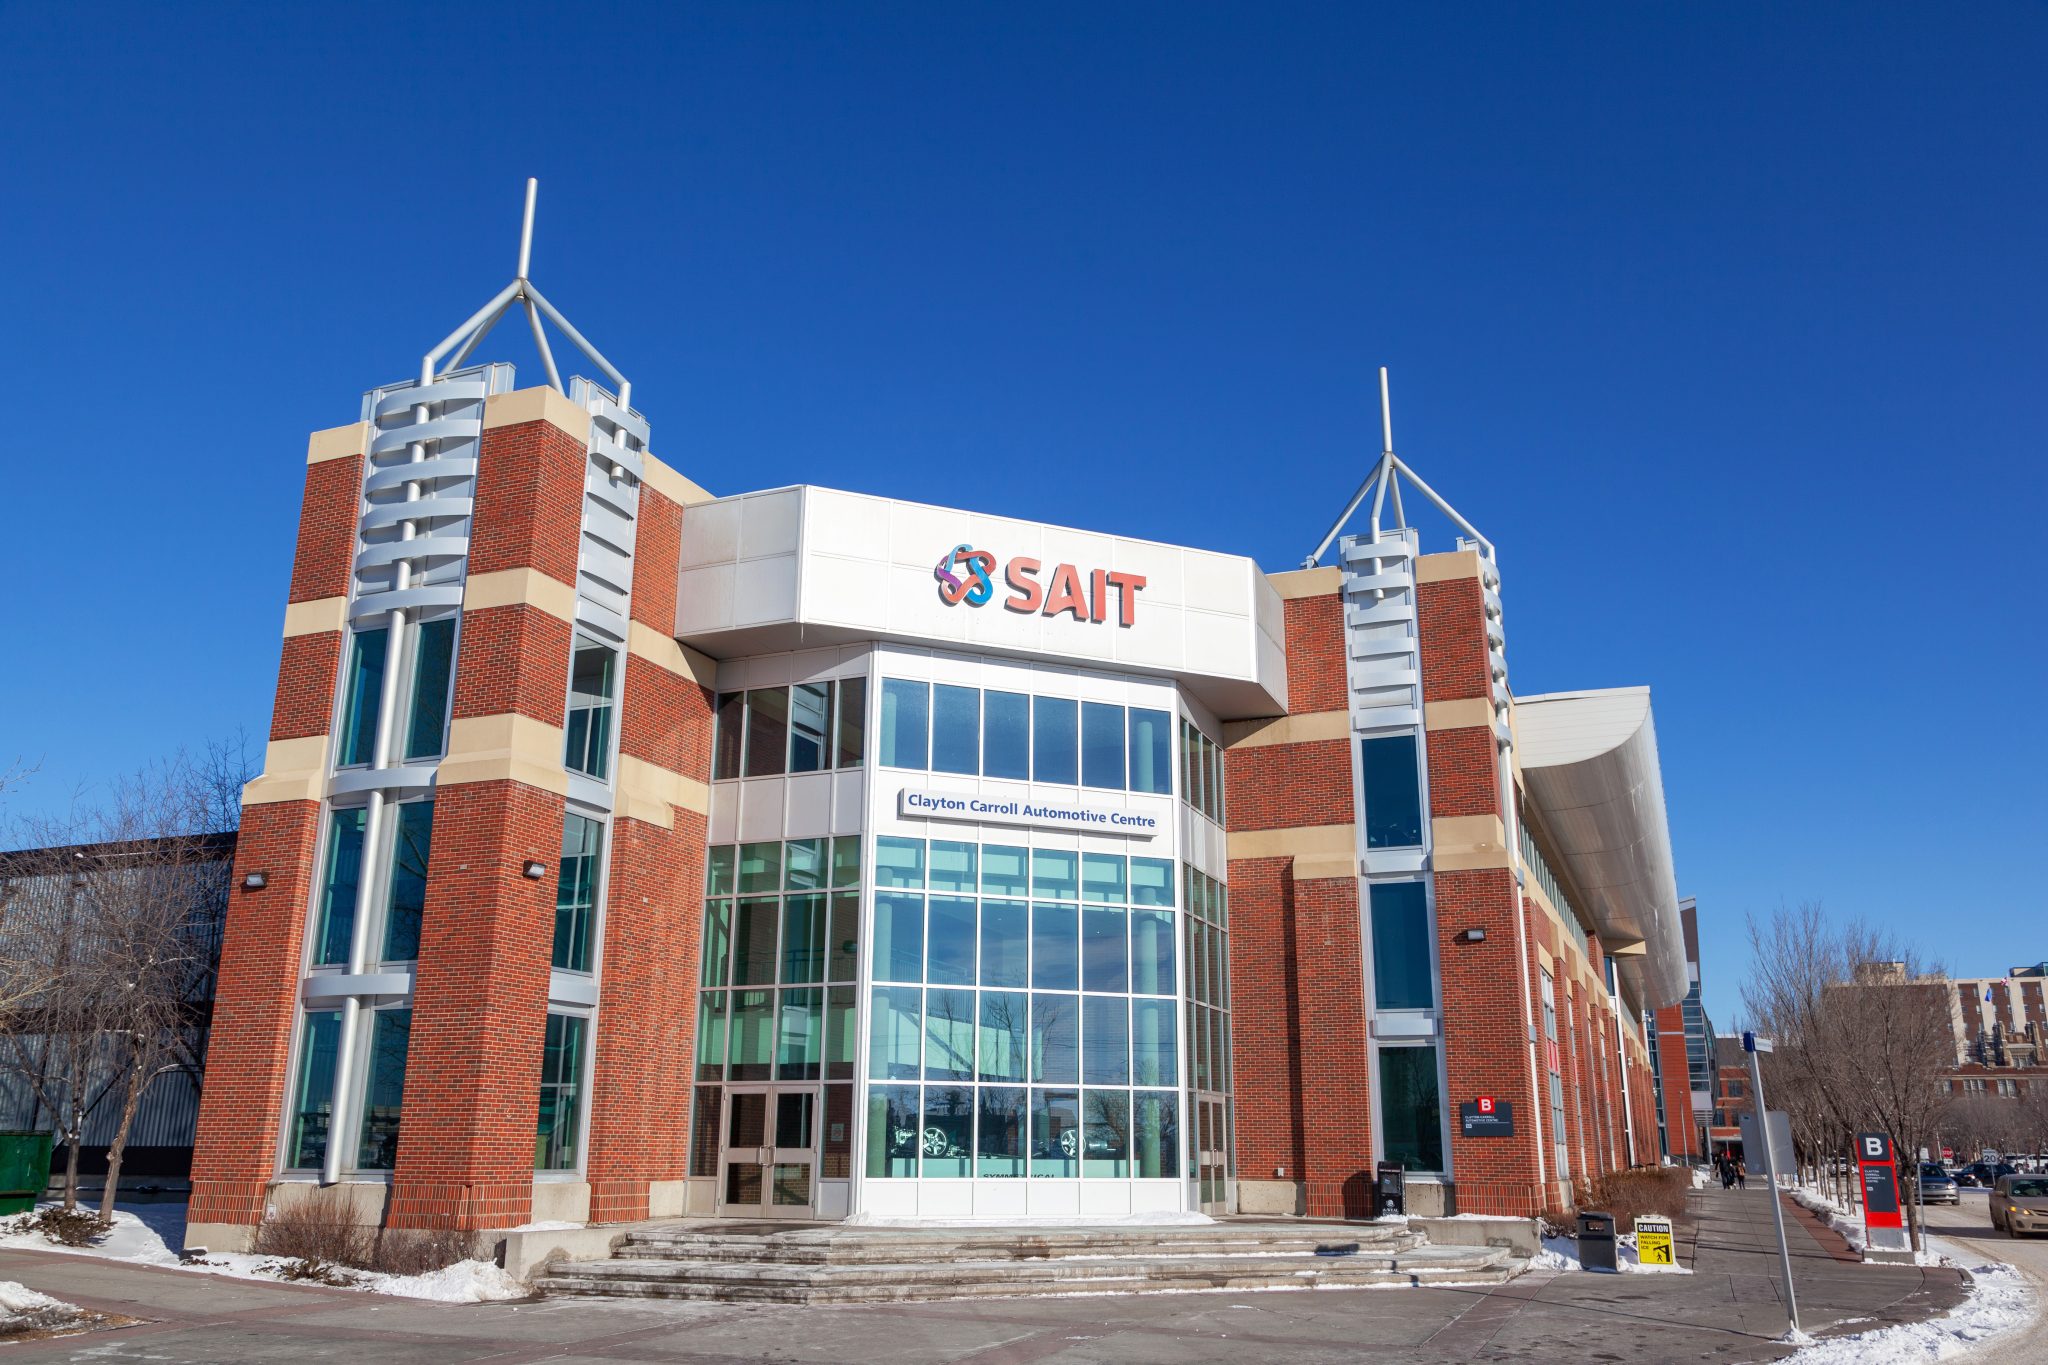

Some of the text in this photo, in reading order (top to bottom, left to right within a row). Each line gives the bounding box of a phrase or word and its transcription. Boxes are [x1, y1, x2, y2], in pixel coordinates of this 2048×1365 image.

[1005, 556, 1147, 628] SAIT
[908, 794, 1156, 827] Clayton Carroll Automotive Centre
[1481, 1098, 1492, 1111] B
[1865, 1137, 1883, 1156] B
[1984, 1155, 1996, 1163] 20
[1638, 1224, 1669, 1233] CAUTION
